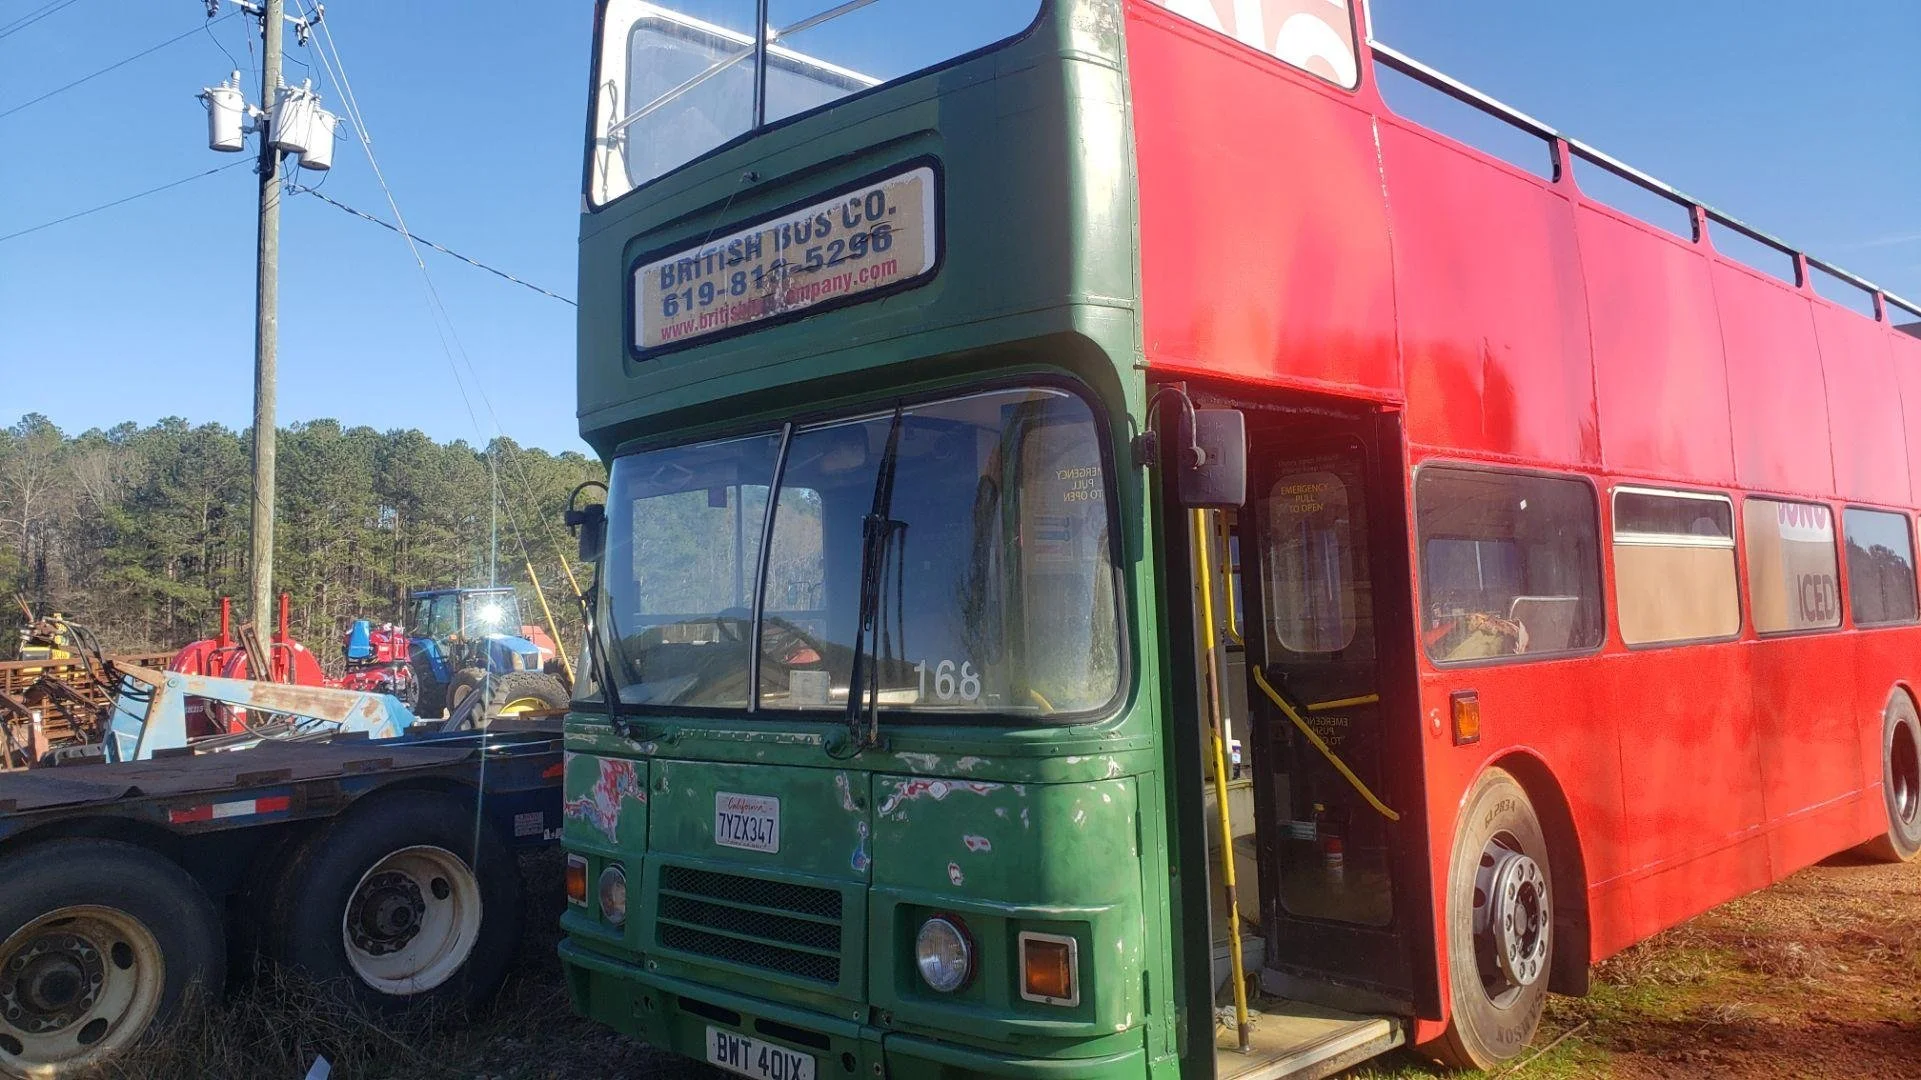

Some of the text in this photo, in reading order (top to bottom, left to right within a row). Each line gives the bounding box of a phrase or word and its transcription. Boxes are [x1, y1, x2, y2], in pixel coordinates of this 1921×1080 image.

[660, 189, 896, 290] BRITISH BUS CO.
[1797, 574, 1836, 622] ICED
[914, 659, 981, 701] 168
[728, 797, 763, 813] California
[719, 812, 774, 844] 7YZX347
[717, 1032, 752, 1070] BWT
